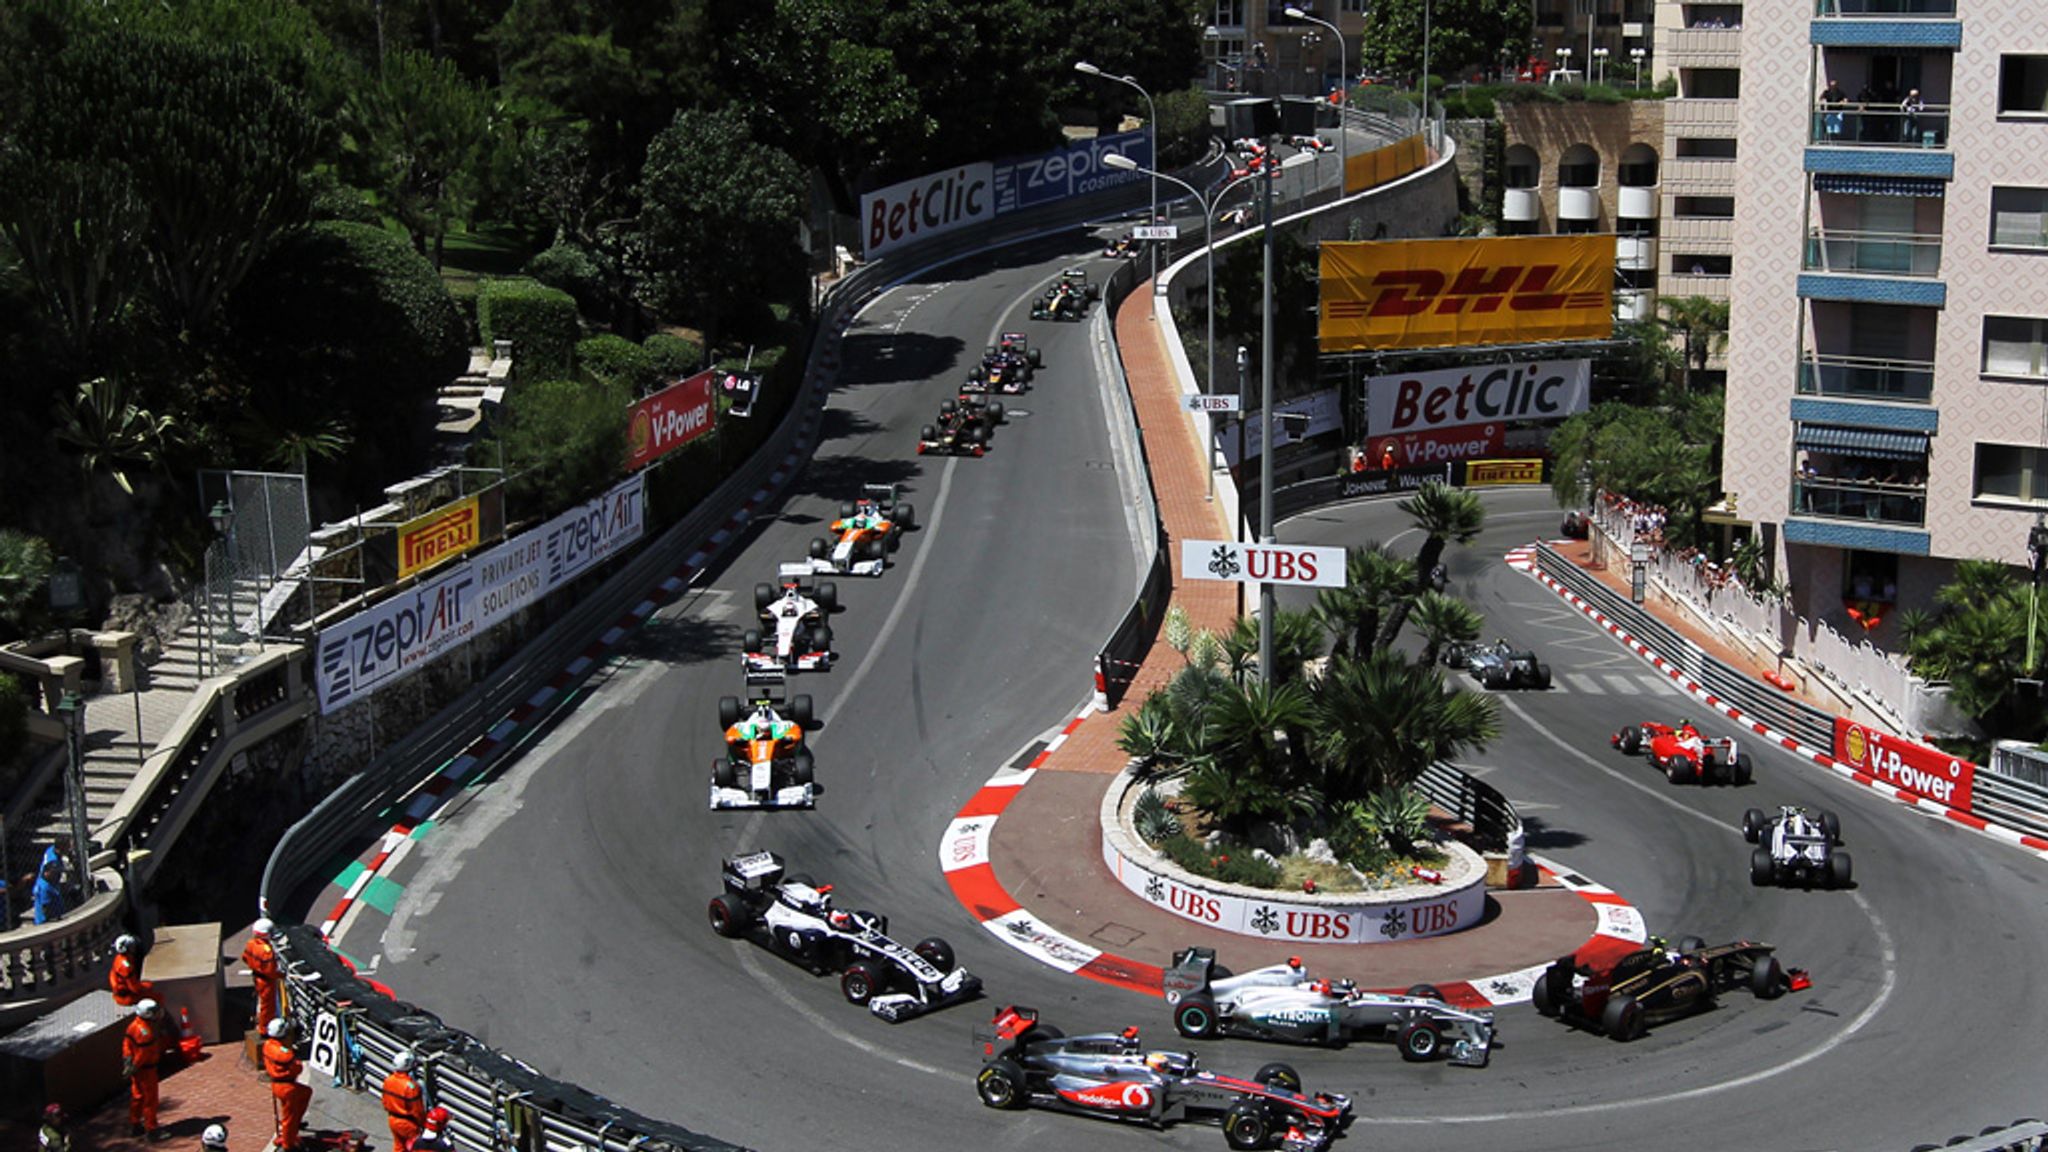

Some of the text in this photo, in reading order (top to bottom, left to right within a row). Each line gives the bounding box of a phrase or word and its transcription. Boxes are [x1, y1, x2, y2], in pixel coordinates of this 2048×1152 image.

[870, 169, 985, 250] BetClic
[1368, 264, 1568, 317] DHL
[736, 379, 750, 391] LG
[1392, 364, 1564, 429] BetClic
[1202, 398, 1229, 409] UBS
[652, 402, 709, 447] V-Power
[1405, 439, 1488, 463] V-Power
[1342, 478, 1388, 496] JOHNNIE
[1472, 463, 1535, 481] PIRELLI
[404, 508, 473, 569] PIRELLI
[482, 538, 542, 587] PRIVATE JET
[1245, 549, 1318, 582] UBS
[483, 568, 539, 617] SOLUTIONS
[1869, 743, 1956, 801] V-Power
[1170, 885, 1221, 922] UBS
[1412, 900, 1457, 934] UBS
[1286, 911, 1351, 939] UBS
[1267, 1009, 1331, 1024] PETRONAS
[315, 1019, 336, 1067] SC
[1077, 1093, 1121, 1106] vodafone
